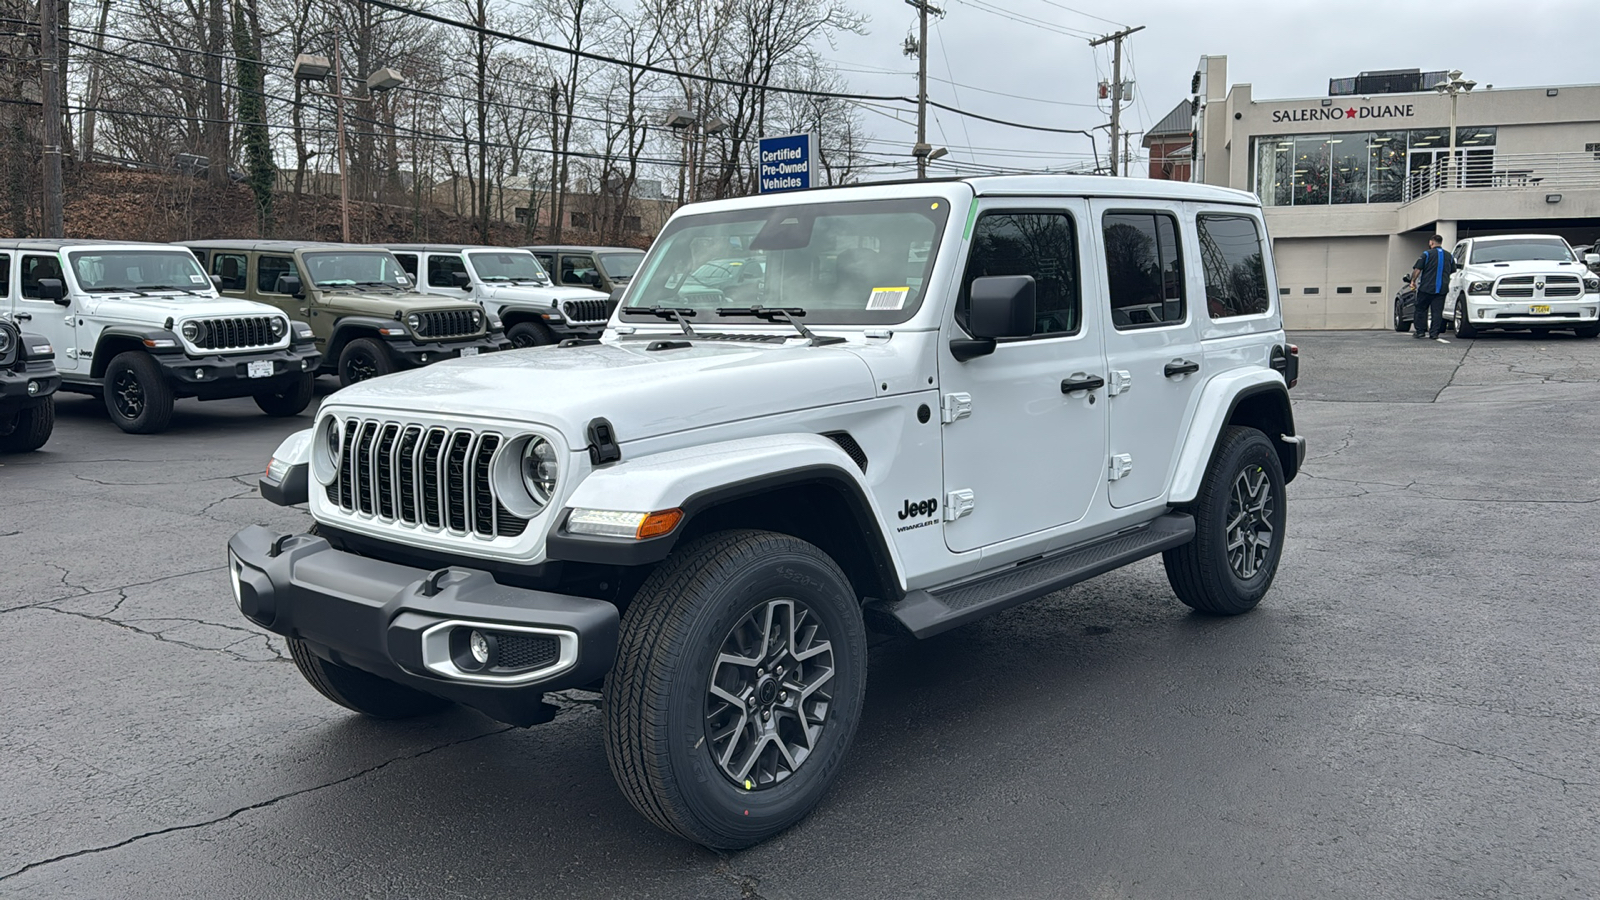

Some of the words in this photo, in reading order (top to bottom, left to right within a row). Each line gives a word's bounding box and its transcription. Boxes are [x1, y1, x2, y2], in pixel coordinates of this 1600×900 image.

[1272, 107, 1344, 123] SALERNO
[1359, 104, 1414, 119] DUANE
[762, 147, 801, 162] Certified
[762, 161, 807, 175] Pre-Owned
[763, 176, 801, 189] Vehicles
[898, 498, 938, 520] Jeep
[897, 520, 933, 533] WRANGLER
